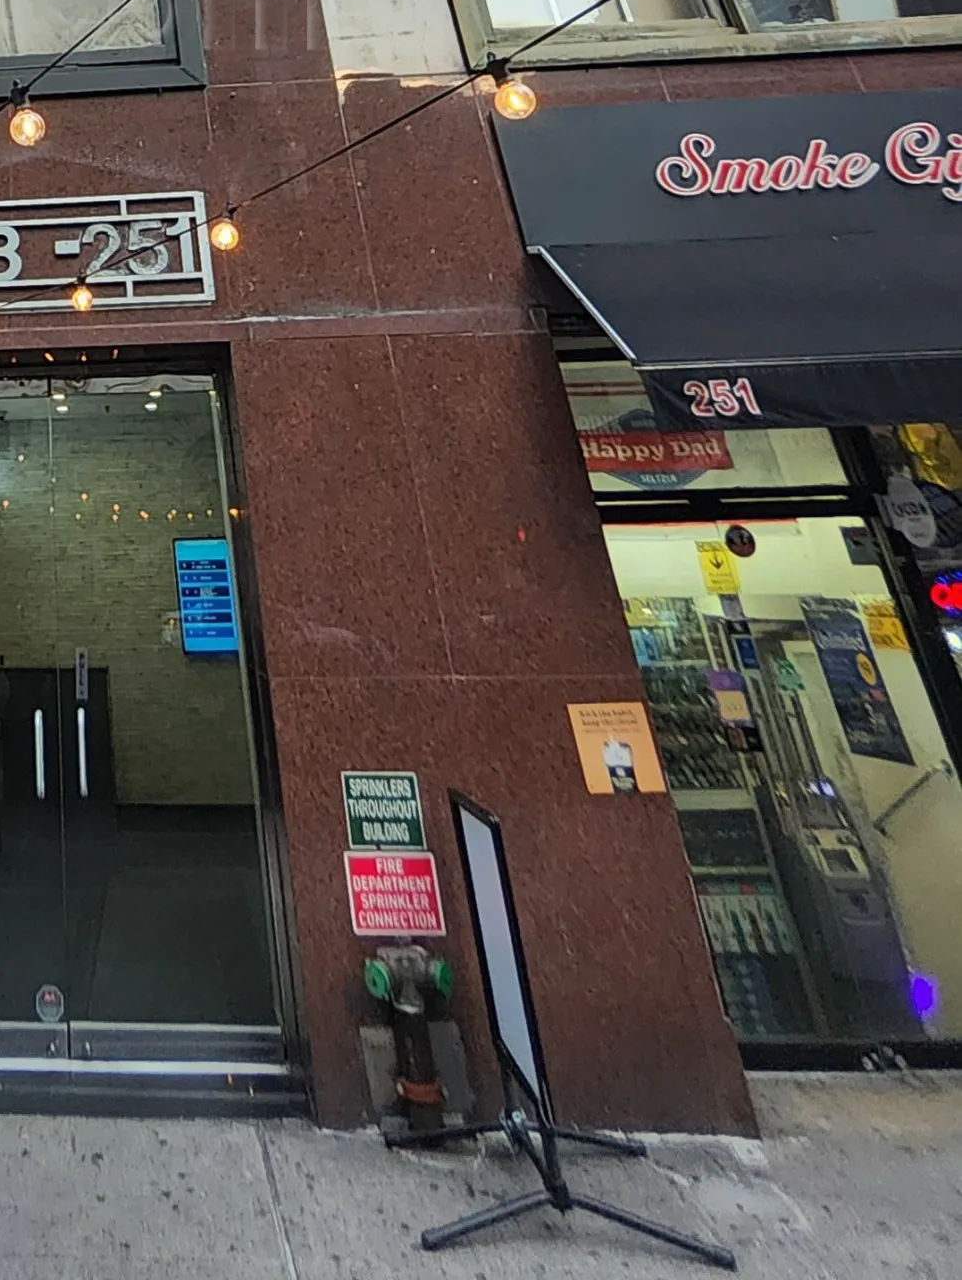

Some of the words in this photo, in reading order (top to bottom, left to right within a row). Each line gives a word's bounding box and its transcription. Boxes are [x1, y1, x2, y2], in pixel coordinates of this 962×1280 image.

[656, 132, 879, 198] Smoke
[683, 377, 762, 417] 251
[579, 438, 664, 461] Happy
[668, 439, 721, 456] Dad
[349, 778, 411, 798] SPRINKLERS
[347, 800, 418, 819] THROUGHOUT
[363, 822, 410, 843] BUILDING
[375, 858, 403, 873] FIRE
[352, 875, 432, 892] DEPARTMENT
[360, 894, 429, 910] SPRINKLER
[359, 911, 436, 929] CONNECTION
